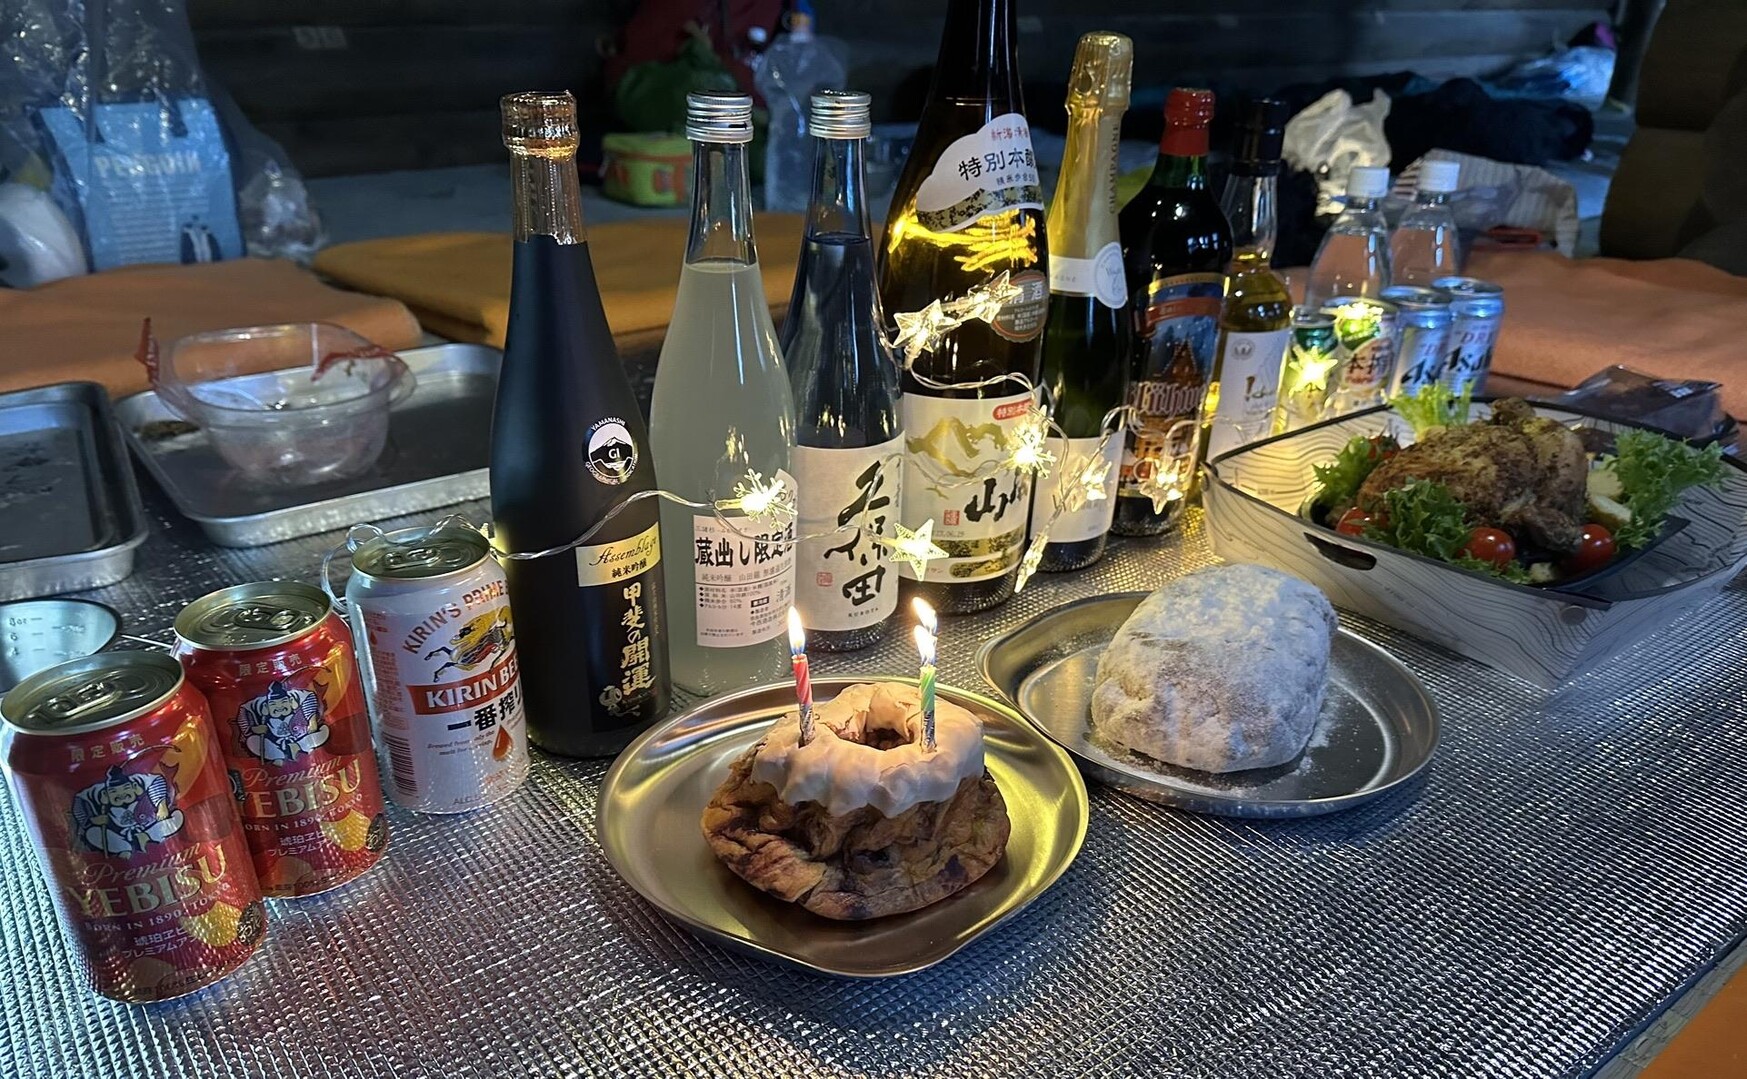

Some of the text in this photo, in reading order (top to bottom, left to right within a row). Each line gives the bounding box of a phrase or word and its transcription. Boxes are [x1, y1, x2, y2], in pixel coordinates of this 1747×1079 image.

[1109, 124, 1119, 214] CHAMPAGNE
[591, 417, 626, 431] YAMANASHI
[608, 447, 620, 459] GI
[589, 534, 657, 567] Assemblage
[611, 558, 647, 578] 純米吟醸
[402, 602, 462, 654] KIRIN'S
[620, 581, 656, 696] 甲斐の開運
[239, 653, 302, 677] 限定販売
[426, 672, 498, 708] KIRIN
[500, 657, 519, 688] BEE
[70, 734, 145, 762] 限定販売
[243, 756, 344, 788] Premium
[240, 759, 361, 818] EBISU
[244, 822, 271, 832] ORN
[275, 822, 289, 832] IN
[85, 842, 200, 885] Premium
[66, 843, 227, 919] YEBISU
[127, 919, 143, 930] IN
[149, 910, 182, 927] 1890
